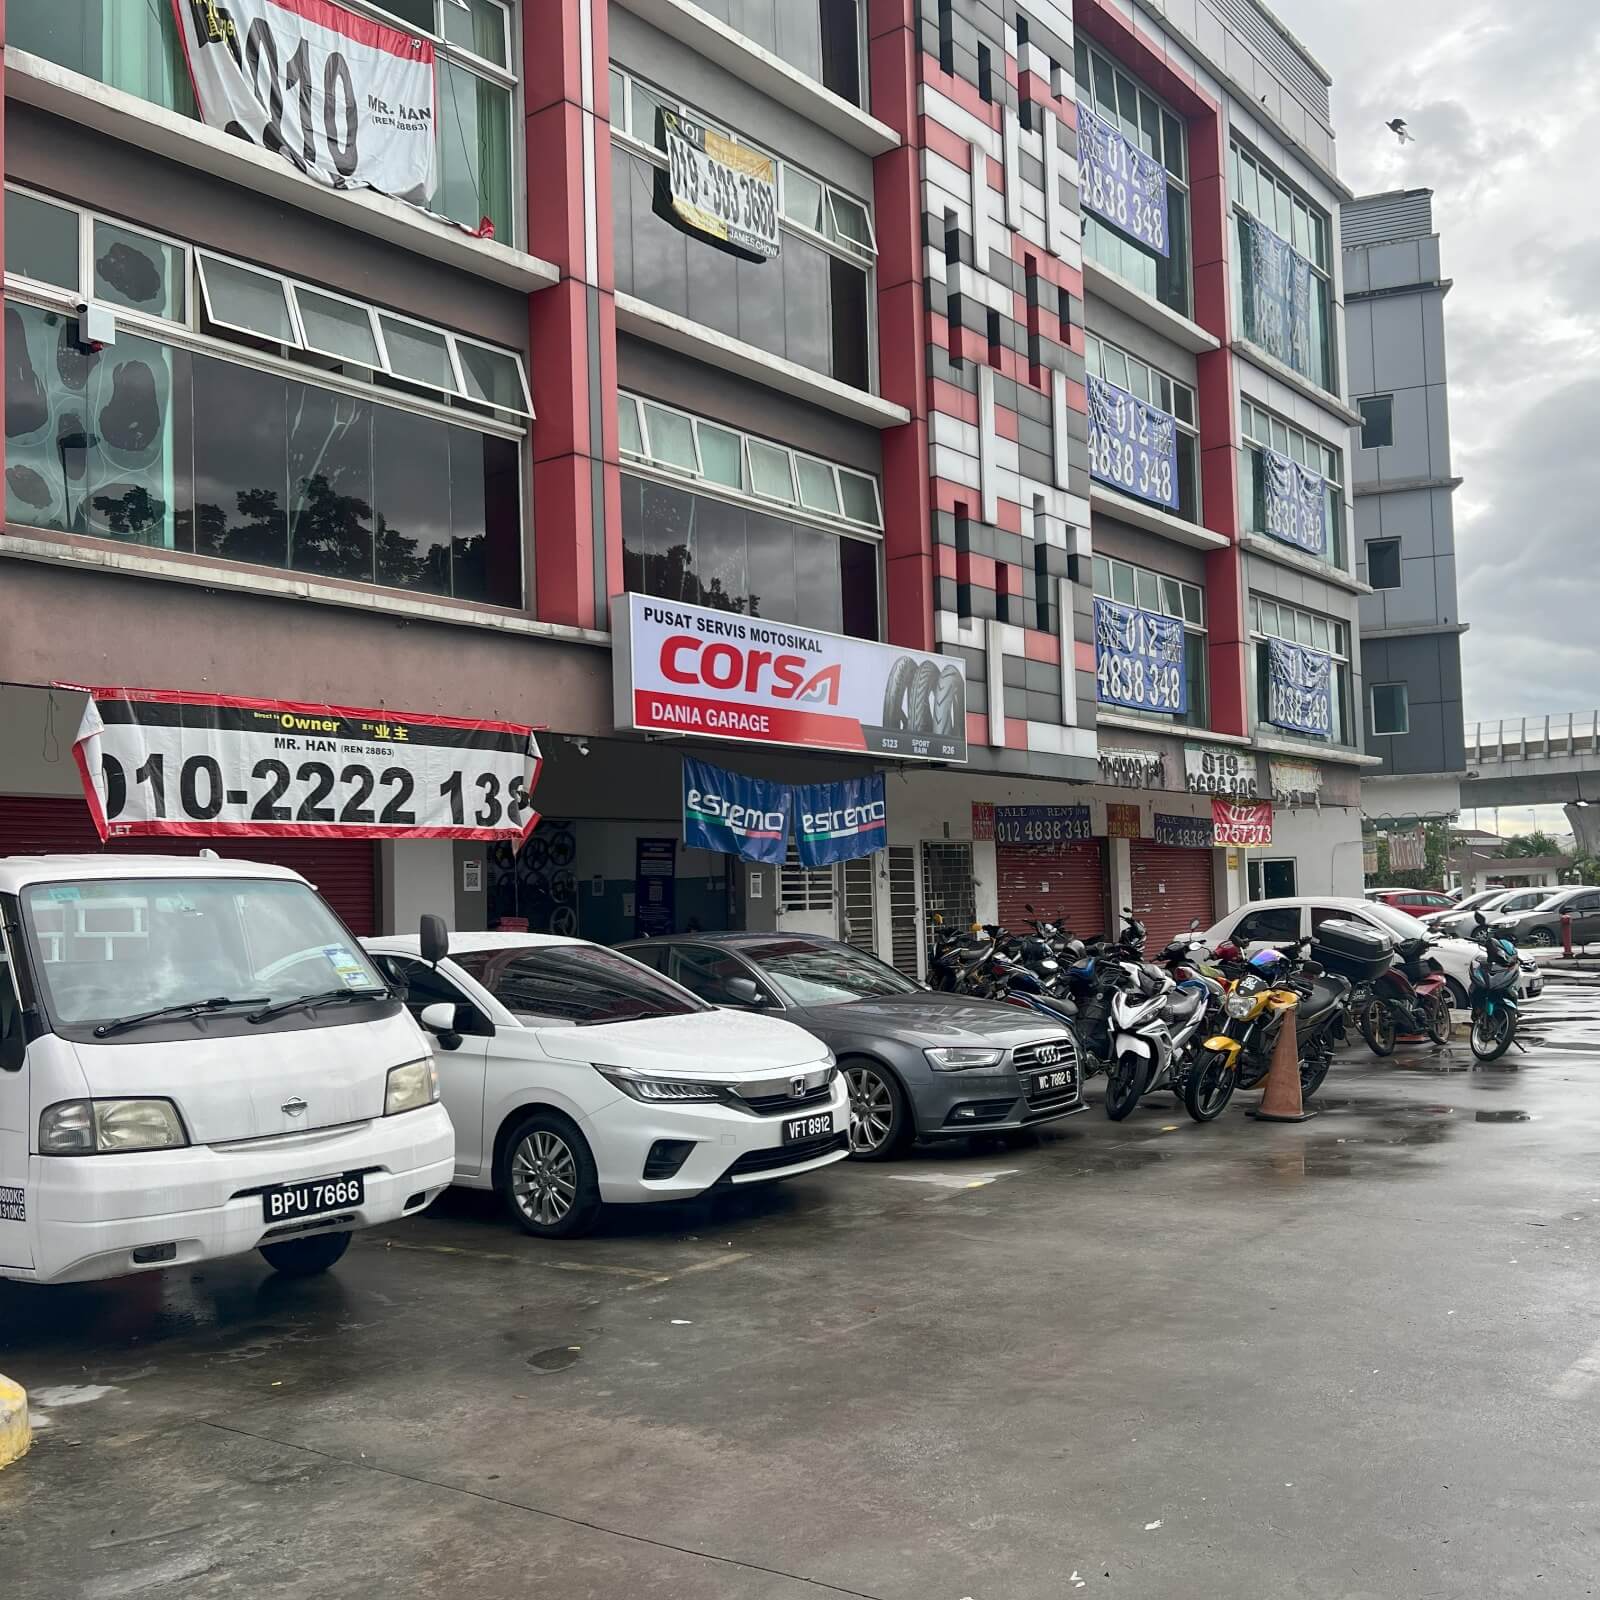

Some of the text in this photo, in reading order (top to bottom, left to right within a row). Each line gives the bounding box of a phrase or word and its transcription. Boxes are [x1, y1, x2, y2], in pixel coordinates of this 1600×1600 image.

[368, 94, 432, 121] MR. HAN
[1108, 134, 1141, 189] 012
[1079, 159, 1128, 225] 4838
[1132, 194, 1163, 249] 348
[729, 228, 755, 247] JAMES
[1115, 394, 1149, 446] 012
[1087, 427, 1172, 501] 4838 348
[643, 606, 823, 653] PUSAT SERVIS MOTOSIKAL
[1126, 612, 1157, 658] 012
[1097, 651, 1180, 709] 4838 348
[281, 713, 341, 733] Owner
[651, 702, 770, 734] DANIA GARAGE
[374, 724, 409, 741] 业主
[881, 738, 898, 749] S123
[274, 737, 395, 757] MR. HAN (REN 28863)
[1202, 752, 1239, 777] 019
[101, 751, 415, 825] 010-2222
[802, 800, 885, 834] estremo
[997, 807, 1027, 817] SALE
[1047, 807, 1073, 817] RENT
[108, 824, 133, 837] LET
[997, 821, 1020, 842] 012
[1024, 820, 1061, 841] 4838
[1064, 820, 1090, 839] 348
[1214, 822, 1272, 843] 6757373
[1038, 1075, 1049, 1090] WC
[789, 1115, 831, 1139] VFT 8912
[0, 1187, 24, 1204] 800KG
[271, 1180, 360, 1216] BPU 7666
